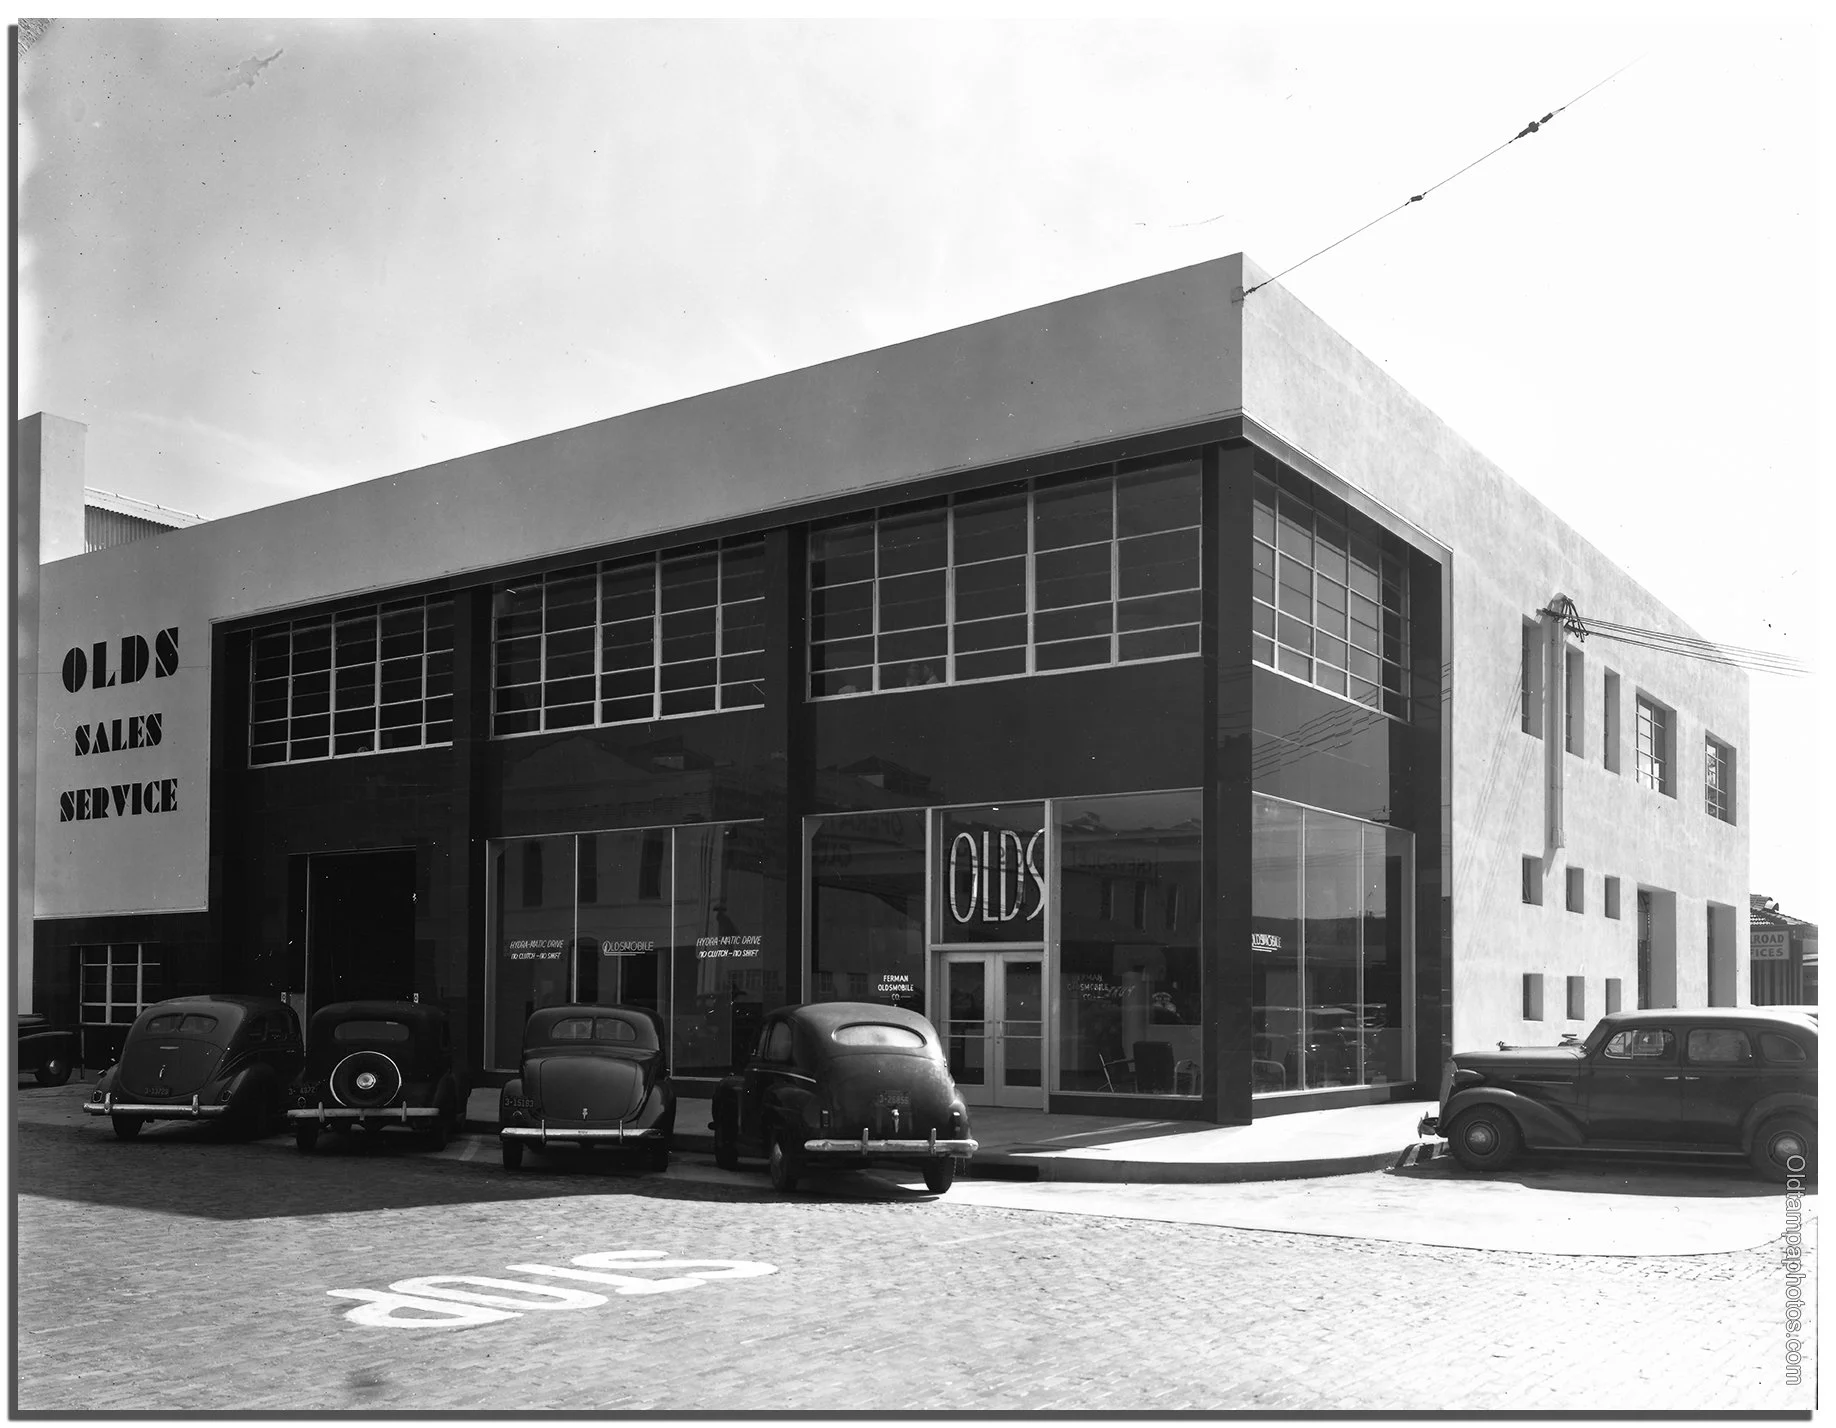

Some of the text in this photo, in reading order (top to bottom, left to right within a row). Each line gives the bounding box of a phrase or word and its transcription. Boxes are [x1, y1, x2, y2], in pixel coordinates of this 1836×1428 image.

[62, 627, 179, 693] OLDS
[75, 713, 162, 756] SALES
[60, 778, 178, 822] SERVICE
[950, 828, 1046, 923] OLDS
[547, 939, 564, 949] DRIVE
[602, 940, 654, 952] OLDSMOBILE
[742, 935, 762, 945] DRIVE
[877, 984, 914, 992] OLDSMOBILE
[883, 974, 909, 982] FERMAN
[326, 1249, 779, 1328] STOP
